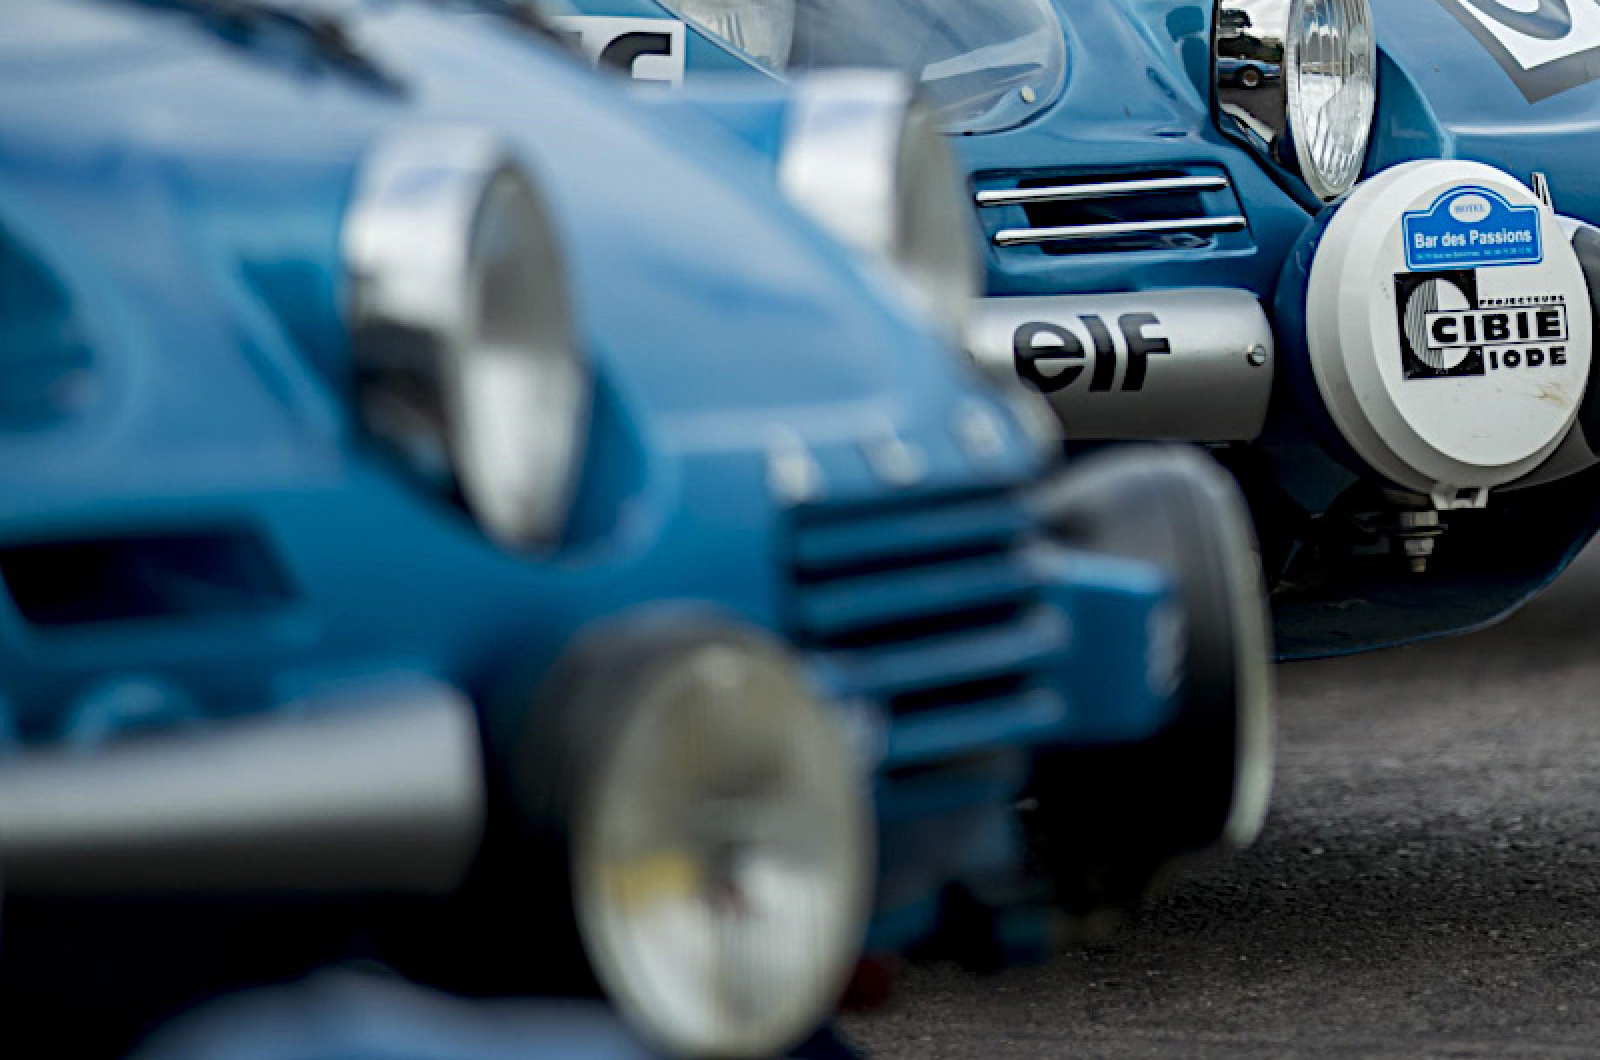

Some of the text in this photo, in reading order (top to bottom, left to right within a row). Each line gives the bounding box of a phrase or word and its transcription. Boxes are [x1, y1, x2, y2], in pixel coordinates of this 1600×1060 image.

[1414, 228, 1533, 249] Bar des Passions
[1014, 311, 1171, 393] elf
[1489, 346, 1566, 370] IODE
